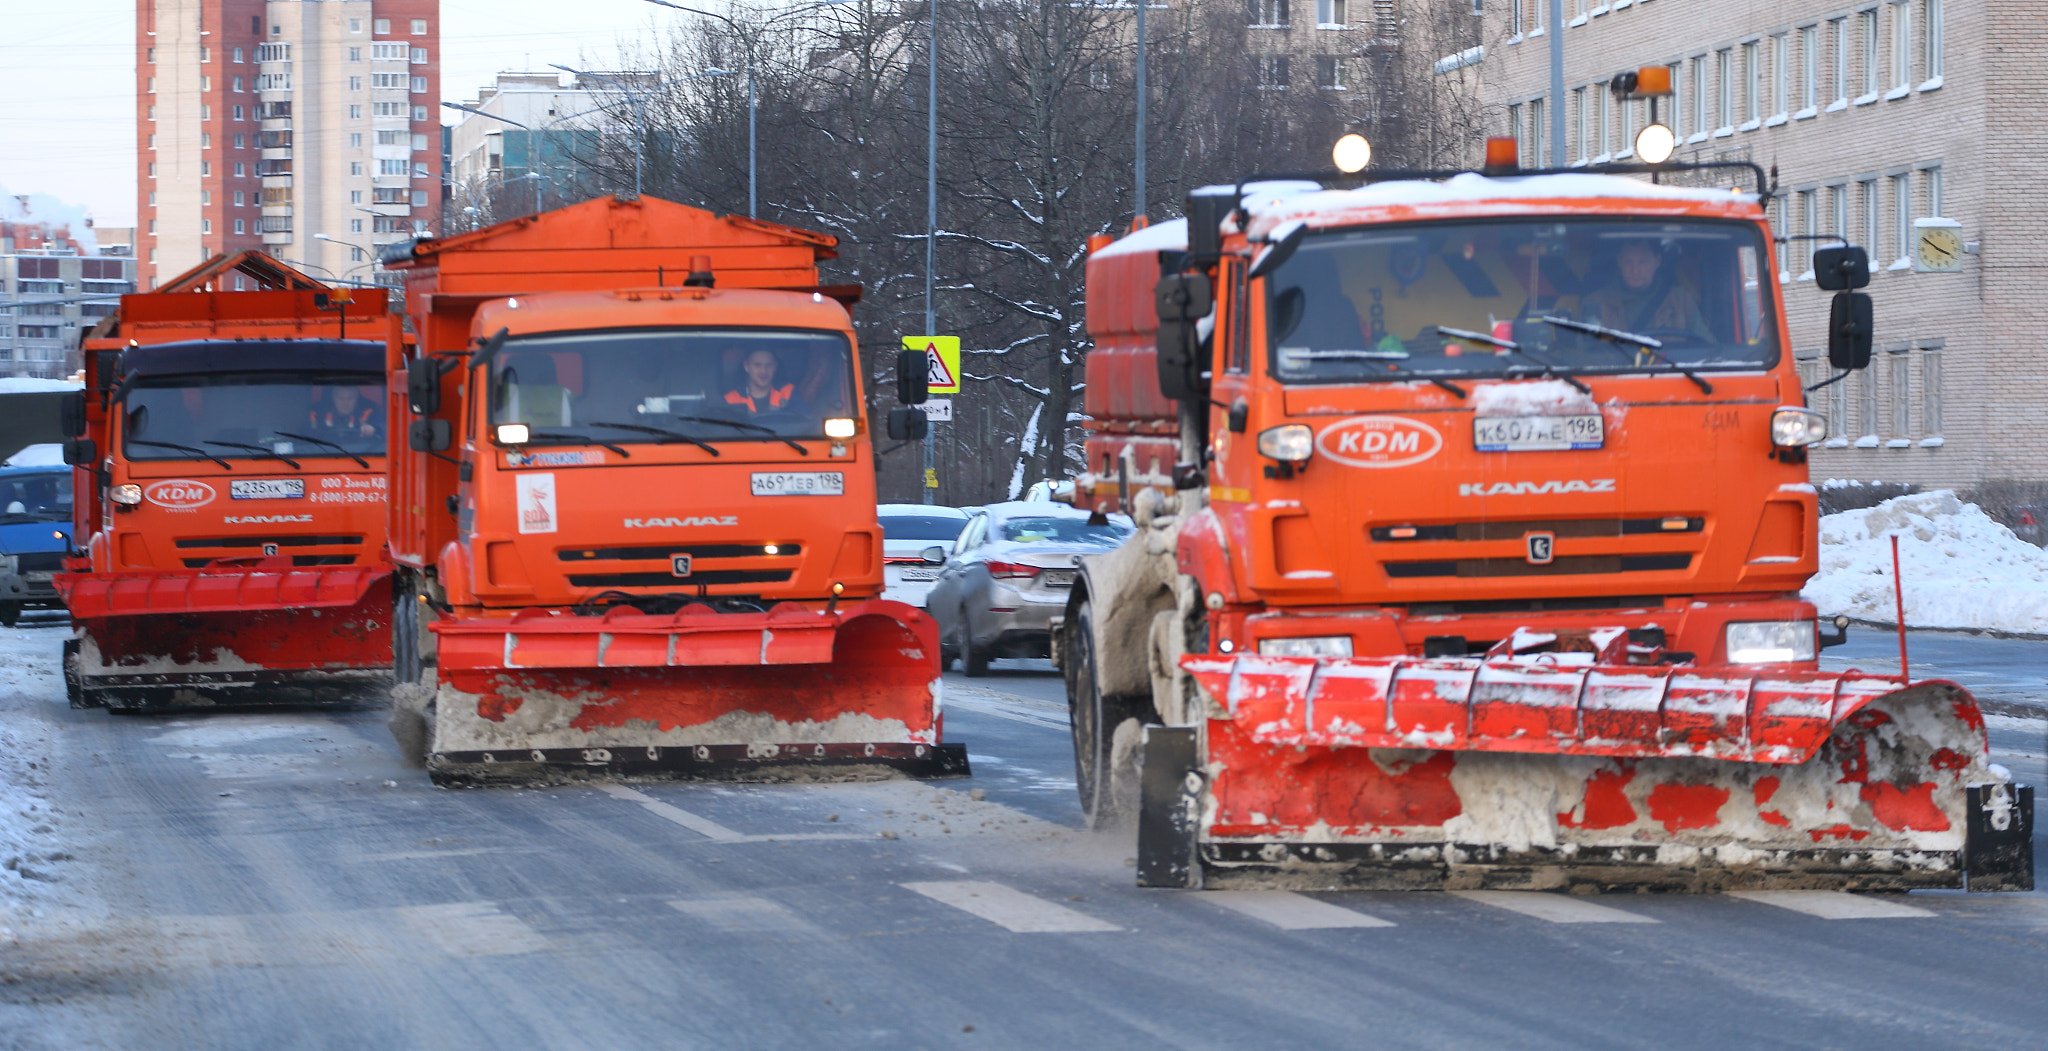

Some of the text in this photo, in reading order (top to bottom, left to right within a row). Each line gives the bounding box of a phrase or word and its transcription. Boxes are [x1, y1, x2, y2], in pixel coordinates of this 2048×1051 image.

[1567, 418, 1600, 434] 198
[1338, 431, 1420, 453] KDM
[818, 474, 842, 486] 198
[157, 487, 204, 501] KDM
[1459, 479, 1616, 496] KAMAZ
[223, 514, 313, 524] KAMAZ
[624, 516, 738, 528] KAMAZ
